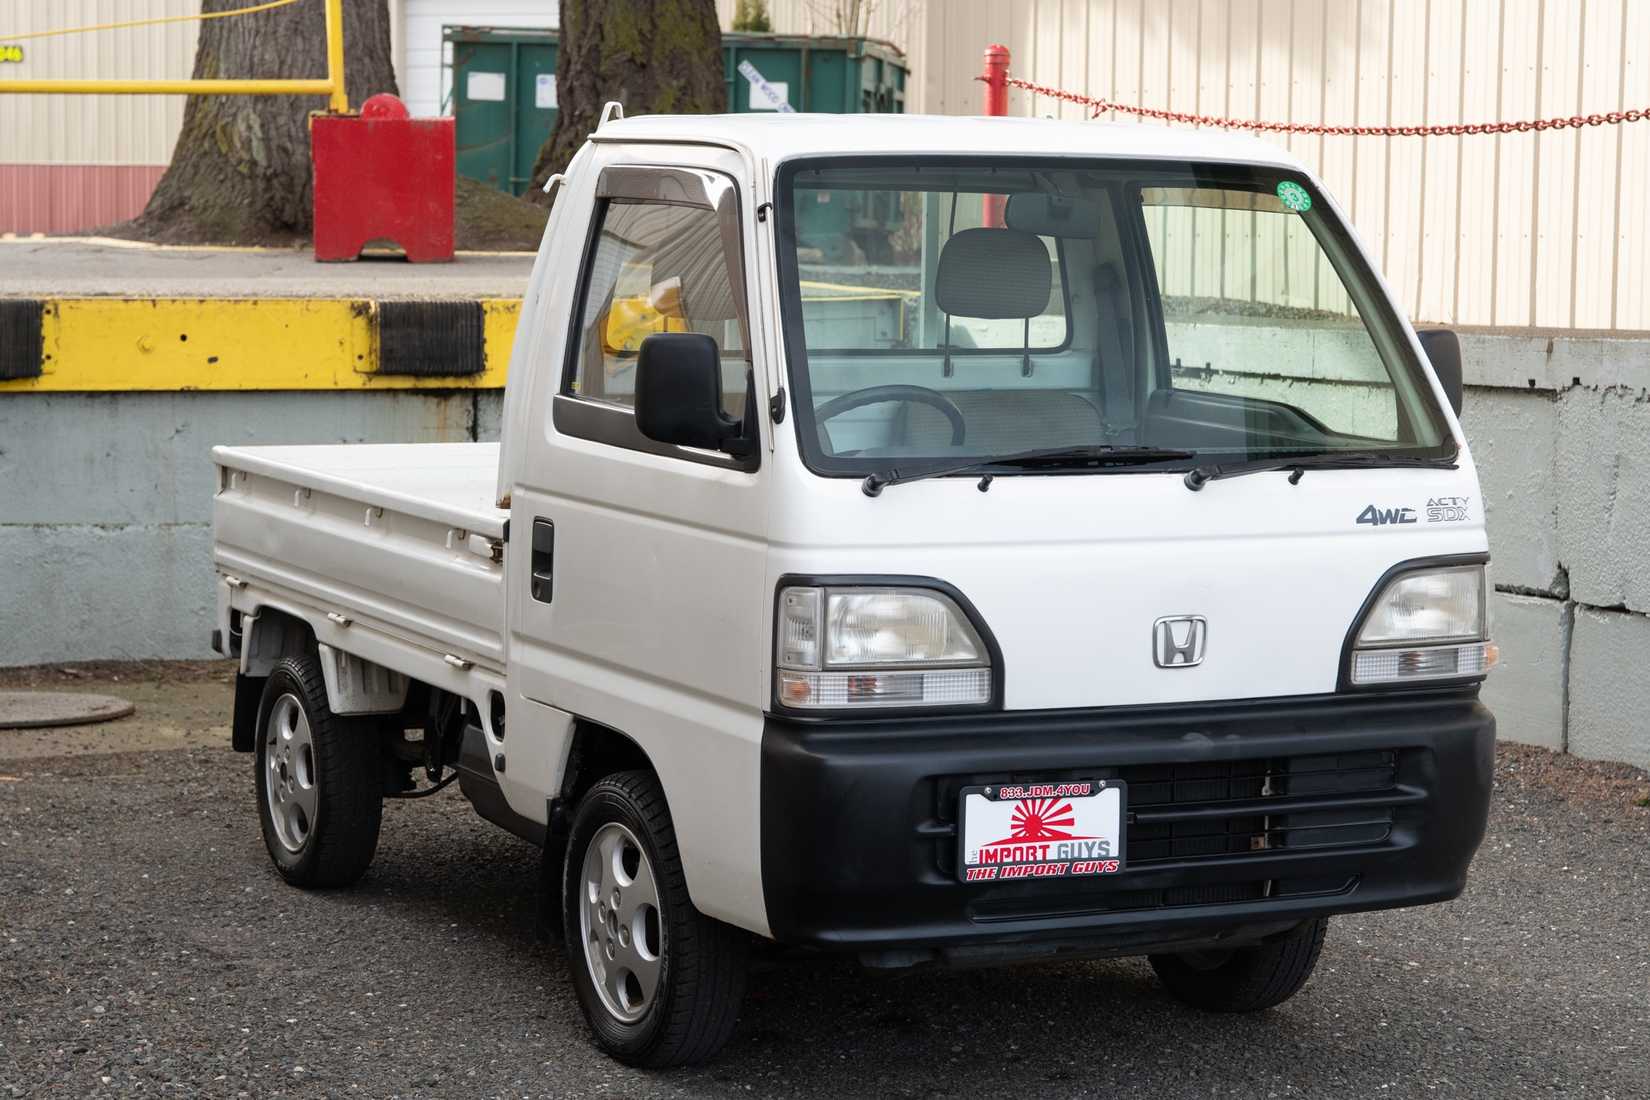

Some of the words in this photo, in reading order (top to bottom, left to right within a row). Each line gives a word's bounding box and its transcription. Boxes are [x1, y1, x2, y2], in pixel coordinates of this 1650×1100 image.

[1426, 497, 1469, 507] ACTY
[1426, 506, 1471, 523] SDX
[1000, 784, 1091, 799] 833.JDM.4YOU
[979, 845, 1050, 864] IMPORT
[1057, 840, 1111, 859] GUYS
[967, 867, 998, 881] THE
[1000, 862, 1071, 878] IMPORT
[1072, 860, 1120, 874] GUYS
